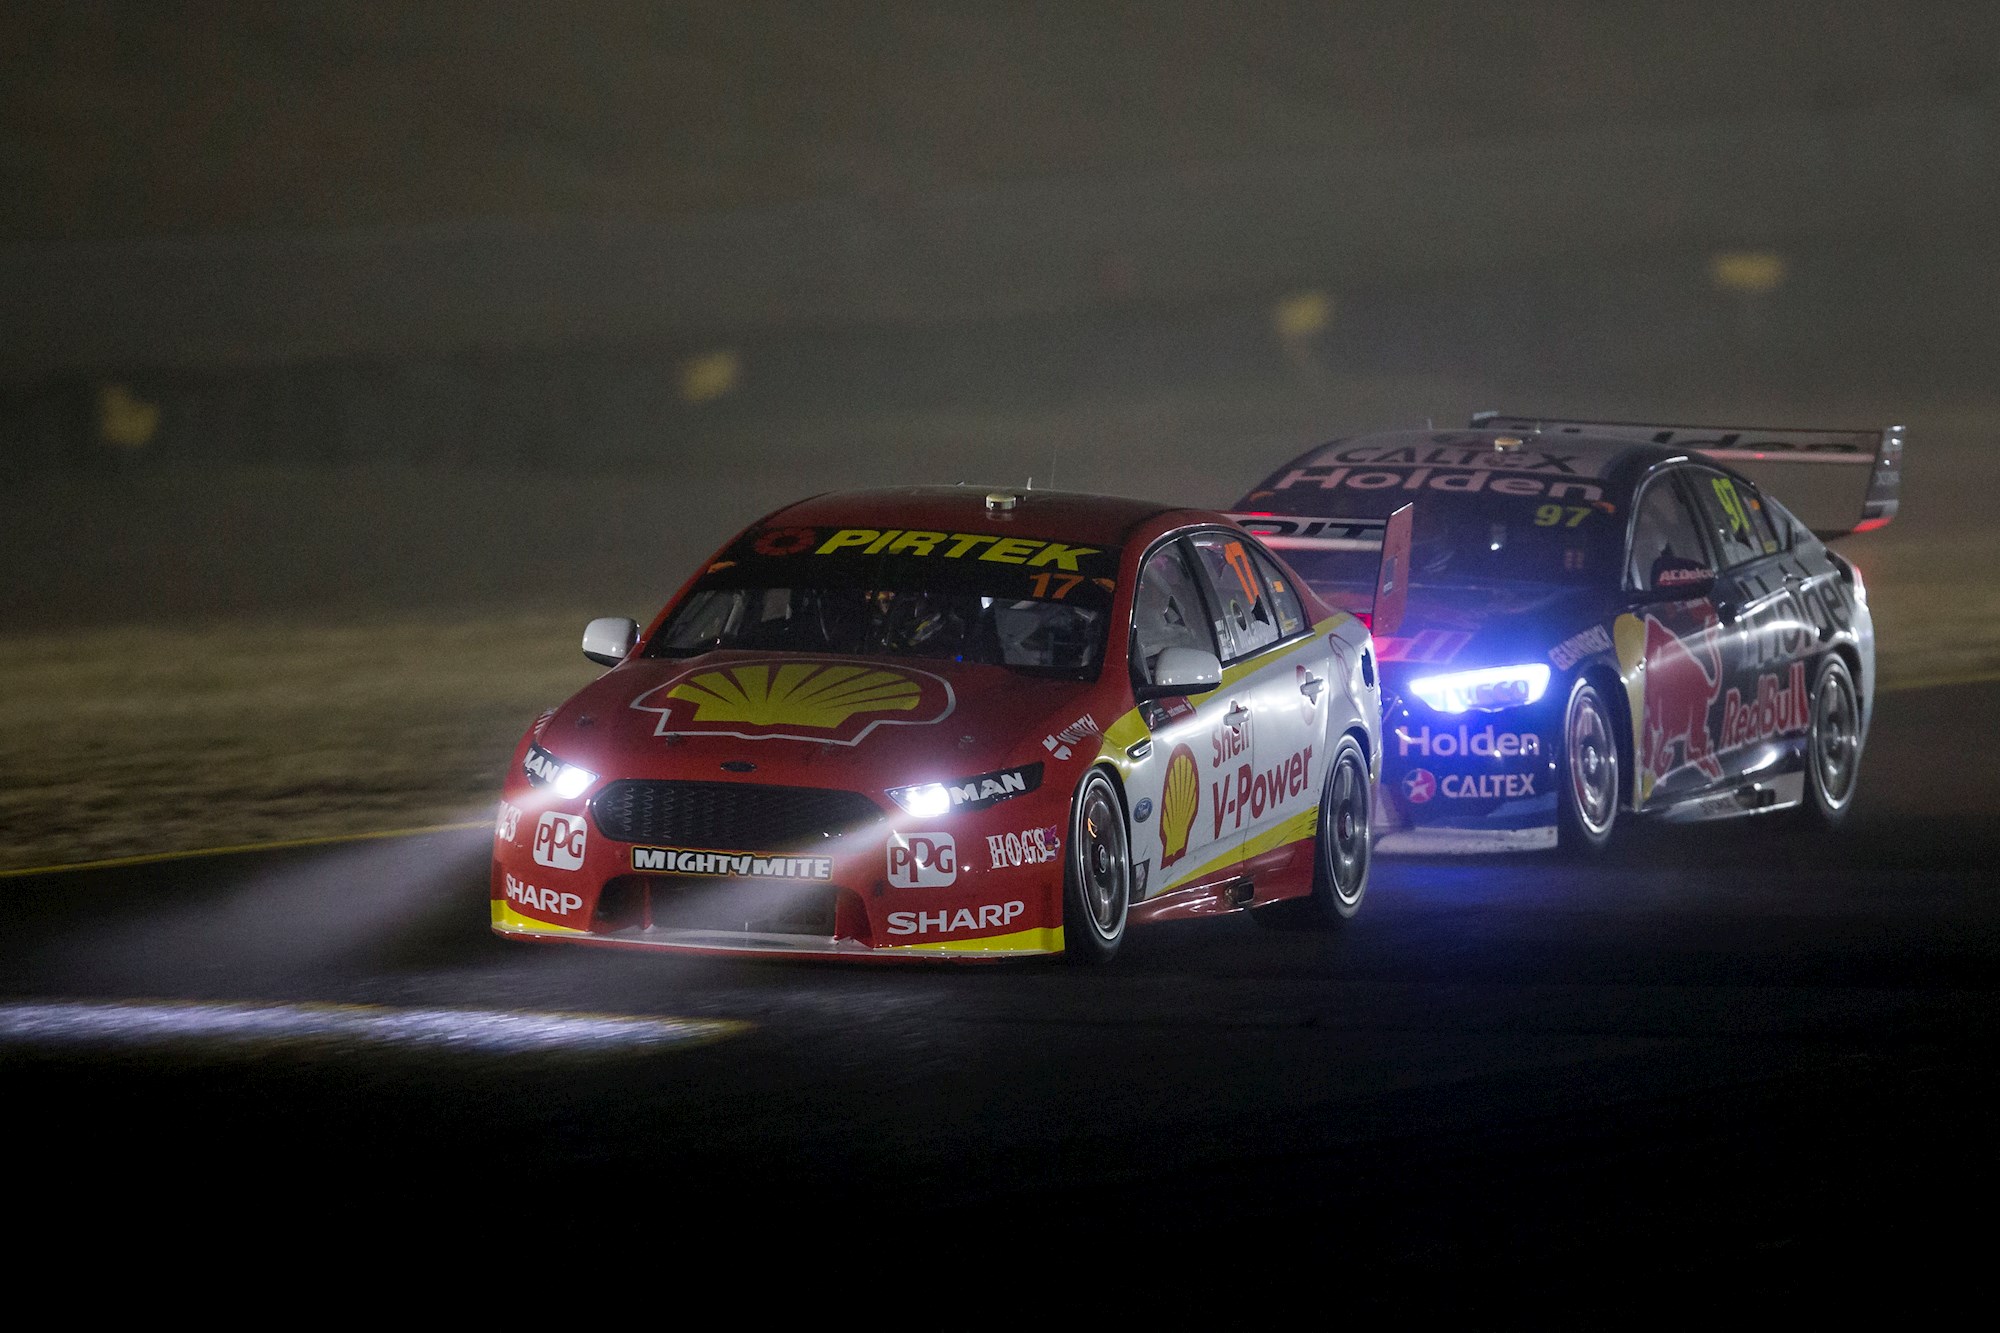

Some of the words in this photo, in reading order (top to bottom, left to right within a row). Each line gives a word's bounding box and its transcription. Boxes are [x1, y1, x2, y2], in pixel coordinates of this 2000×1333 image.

[1335, 446, 1577, 474] CALTEX
[1275, 467, 1604, 500] Holden
[1534, 504, 1591, 527] 97
[1711, 477, 1750, 533] 97
[815, 529, 1100, 571] PIRTEK
[1029, 573, 1084, 599] 17
[1225, 541, 1259, 605] 17
[1212, 722, 1250, 768] Shell
[1398, 724, 1540, 756] Holden
[949, 771, 1026, 805] MAN
[1212, 744, 1312, 840] V-Power
[1442, 773, 1535, 798] CALTEX
[537, 817, 584, 861] PPG
[890, 838, 954, 882] PPG
[505, 874, 582, 916] SHARP
[887, 901, 1025, 935] SHARP
